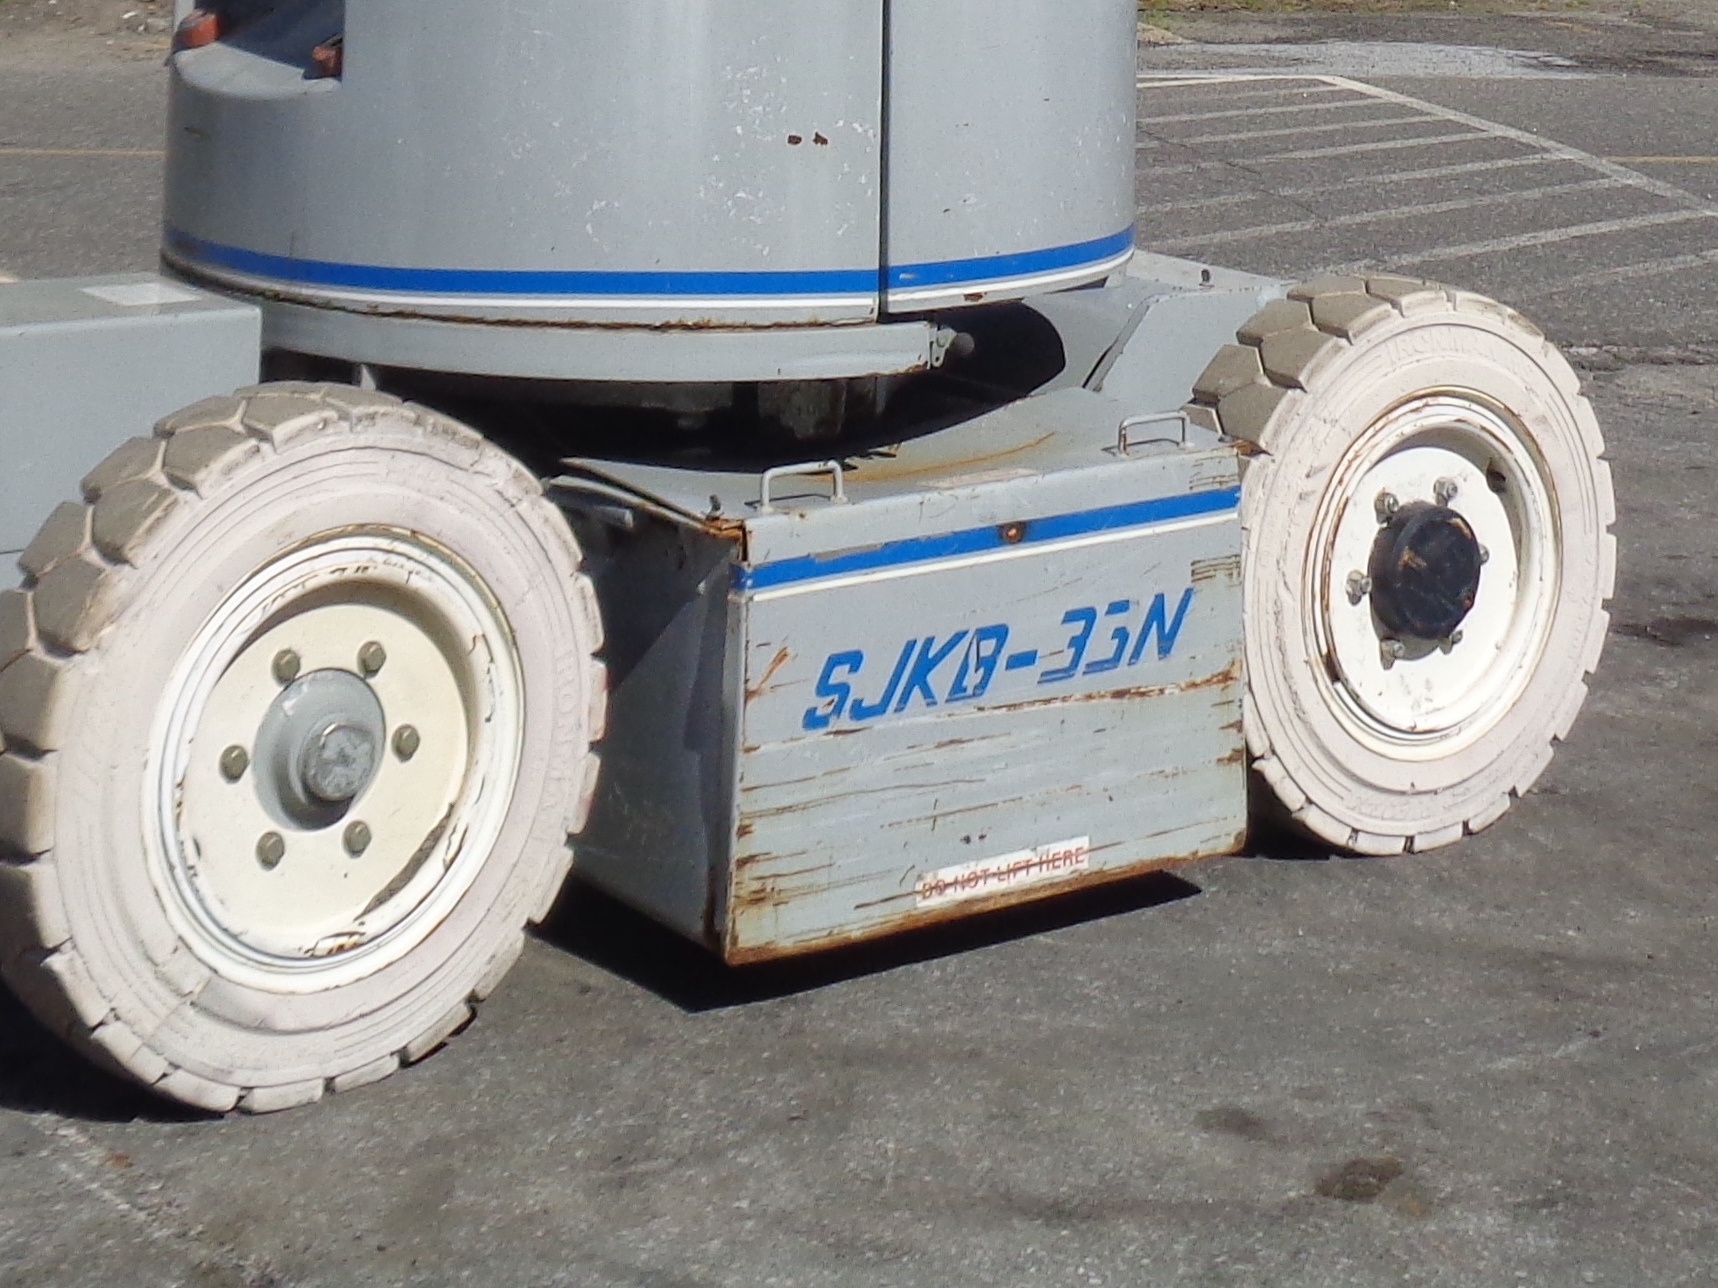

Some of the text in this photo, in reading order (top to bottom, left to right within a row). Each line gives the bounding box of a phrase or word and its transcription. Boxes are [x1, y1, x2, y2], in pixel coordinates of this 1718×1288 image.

[921, 845, 1086, 901] DO NOT LIFT HERE
